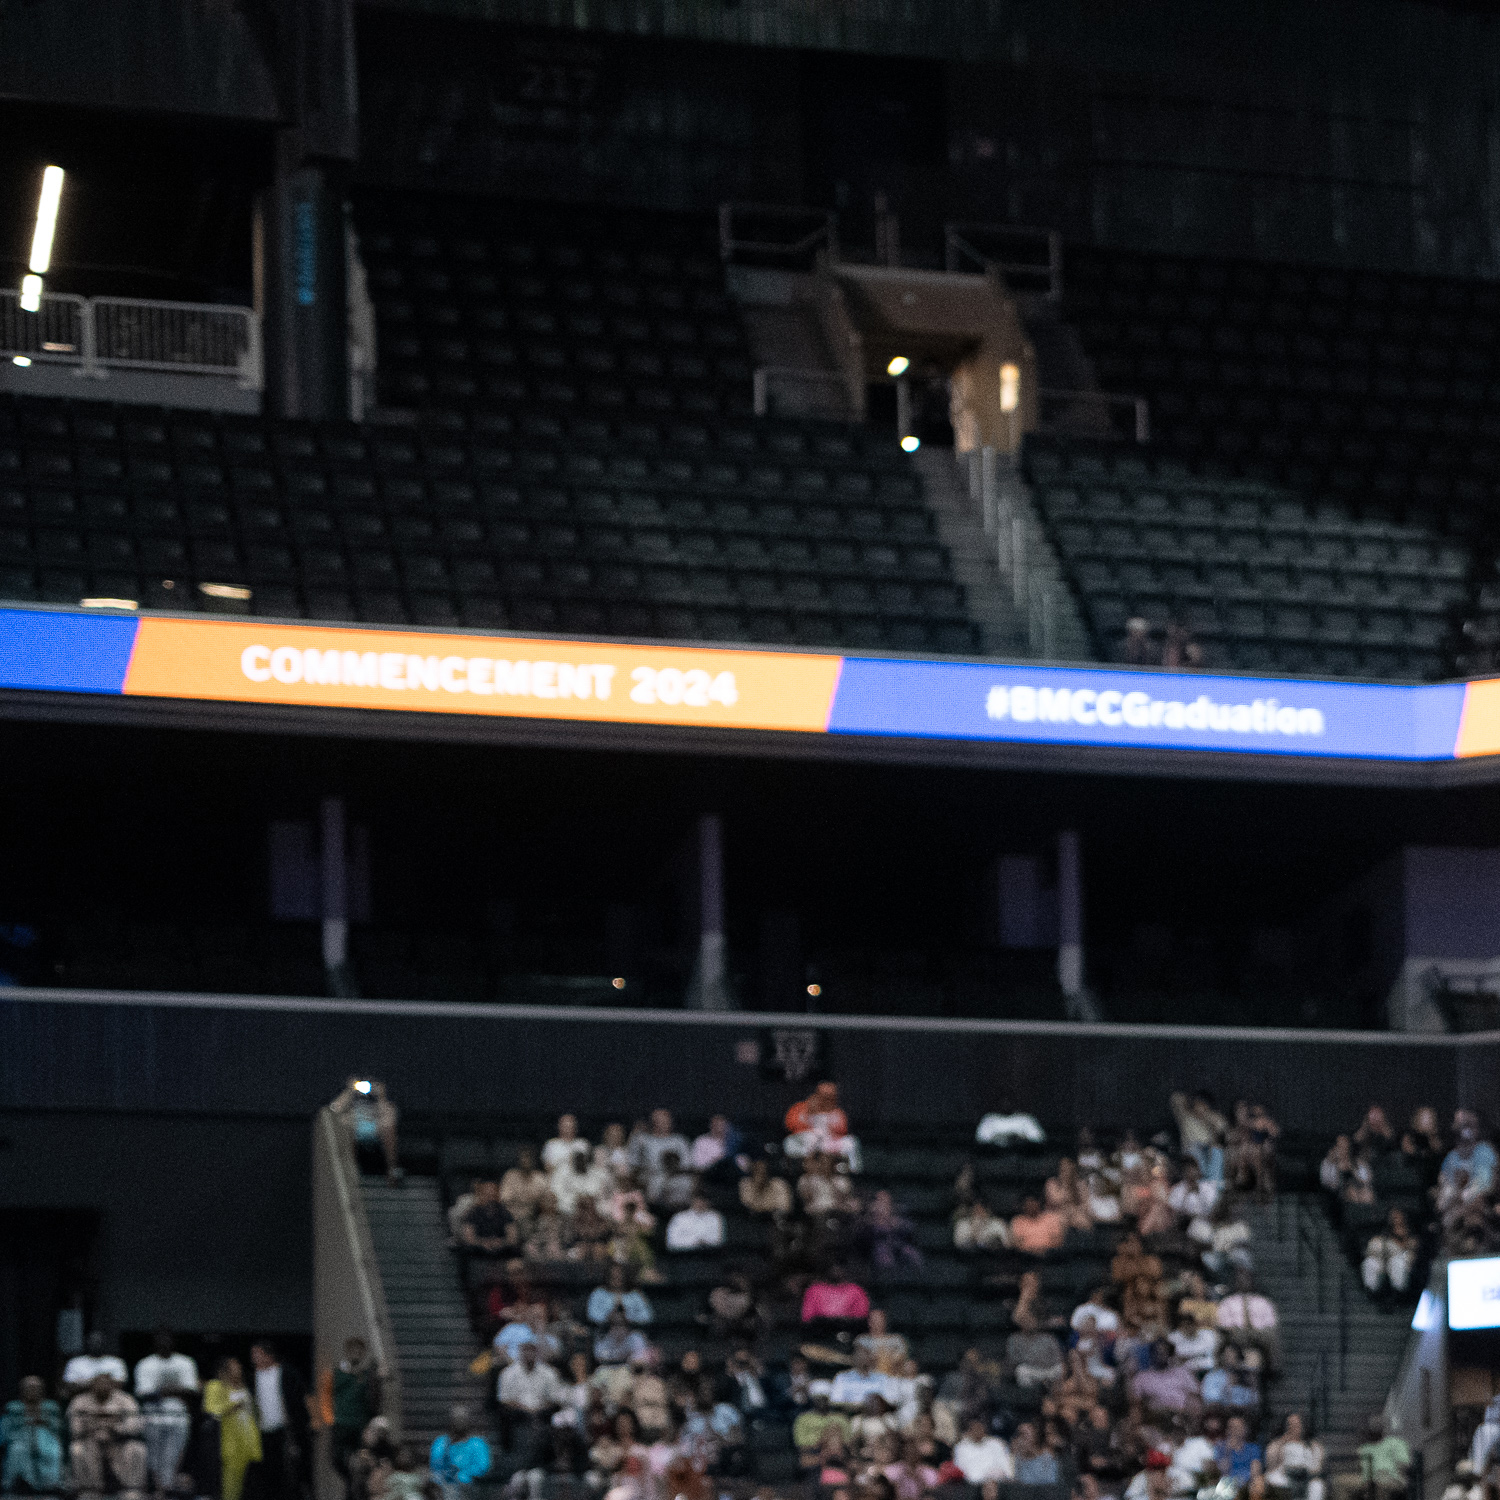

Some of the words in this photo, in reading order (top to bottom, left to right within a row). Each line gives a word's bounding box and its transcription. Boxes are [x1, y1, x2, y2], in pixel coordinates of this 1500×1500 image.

[240, 643, 619, 702] COMMENCEMENT
[629, 663, 740, 709] 2024
[985, 684, 1324, 736] #BMCCGraduation
